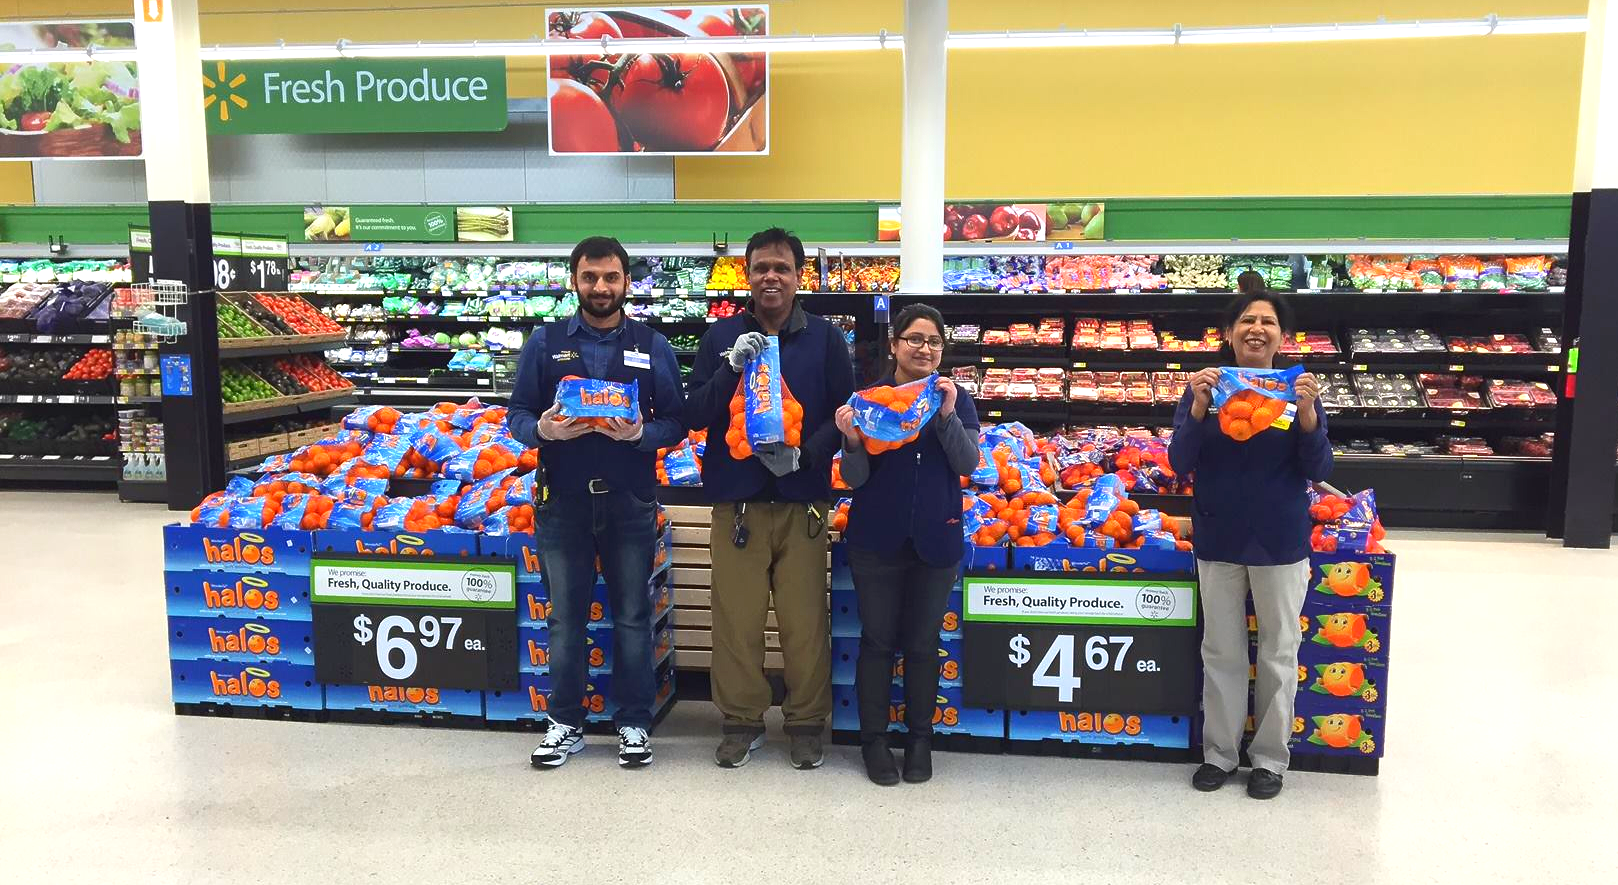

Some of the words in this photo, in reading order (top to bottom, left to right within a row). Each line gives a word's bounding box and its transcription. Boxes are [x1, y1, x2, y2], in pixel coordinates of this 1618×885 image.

[264, 70, 345, 104] Fresh
[356, 68, 488, 103] Produce
[876, 297, 886, 309] A
[580, 386, 631, 409] halos
[203, 536, 275, 566] halos
[328, 568, 341, 577] We
[342, 569, 367, 578] promise:
[328, 578, 360, 590] Fresh,
[362, 579, 401, 594] Quality
[404, 580, 452, 593] Produce.
[466, 577, 493, 589] 100%
[984, 586, 996, 594] We
[997, 586, 1029, 595] promise:
[203, 581, 279, 611] halos
[984, 595, 1020, 608] Fresh,
[1022, 596, 1066, 611] Quality
[1070, 597, 1124, 610] Produce.
[1142, 593, 1172, 606] 100%
[208, 627, 280, 655] halos
[464, 638, 486, 651] ea.
[1136, 659, 1161, 672] ea.
[210, 670, 281, 699] halos
